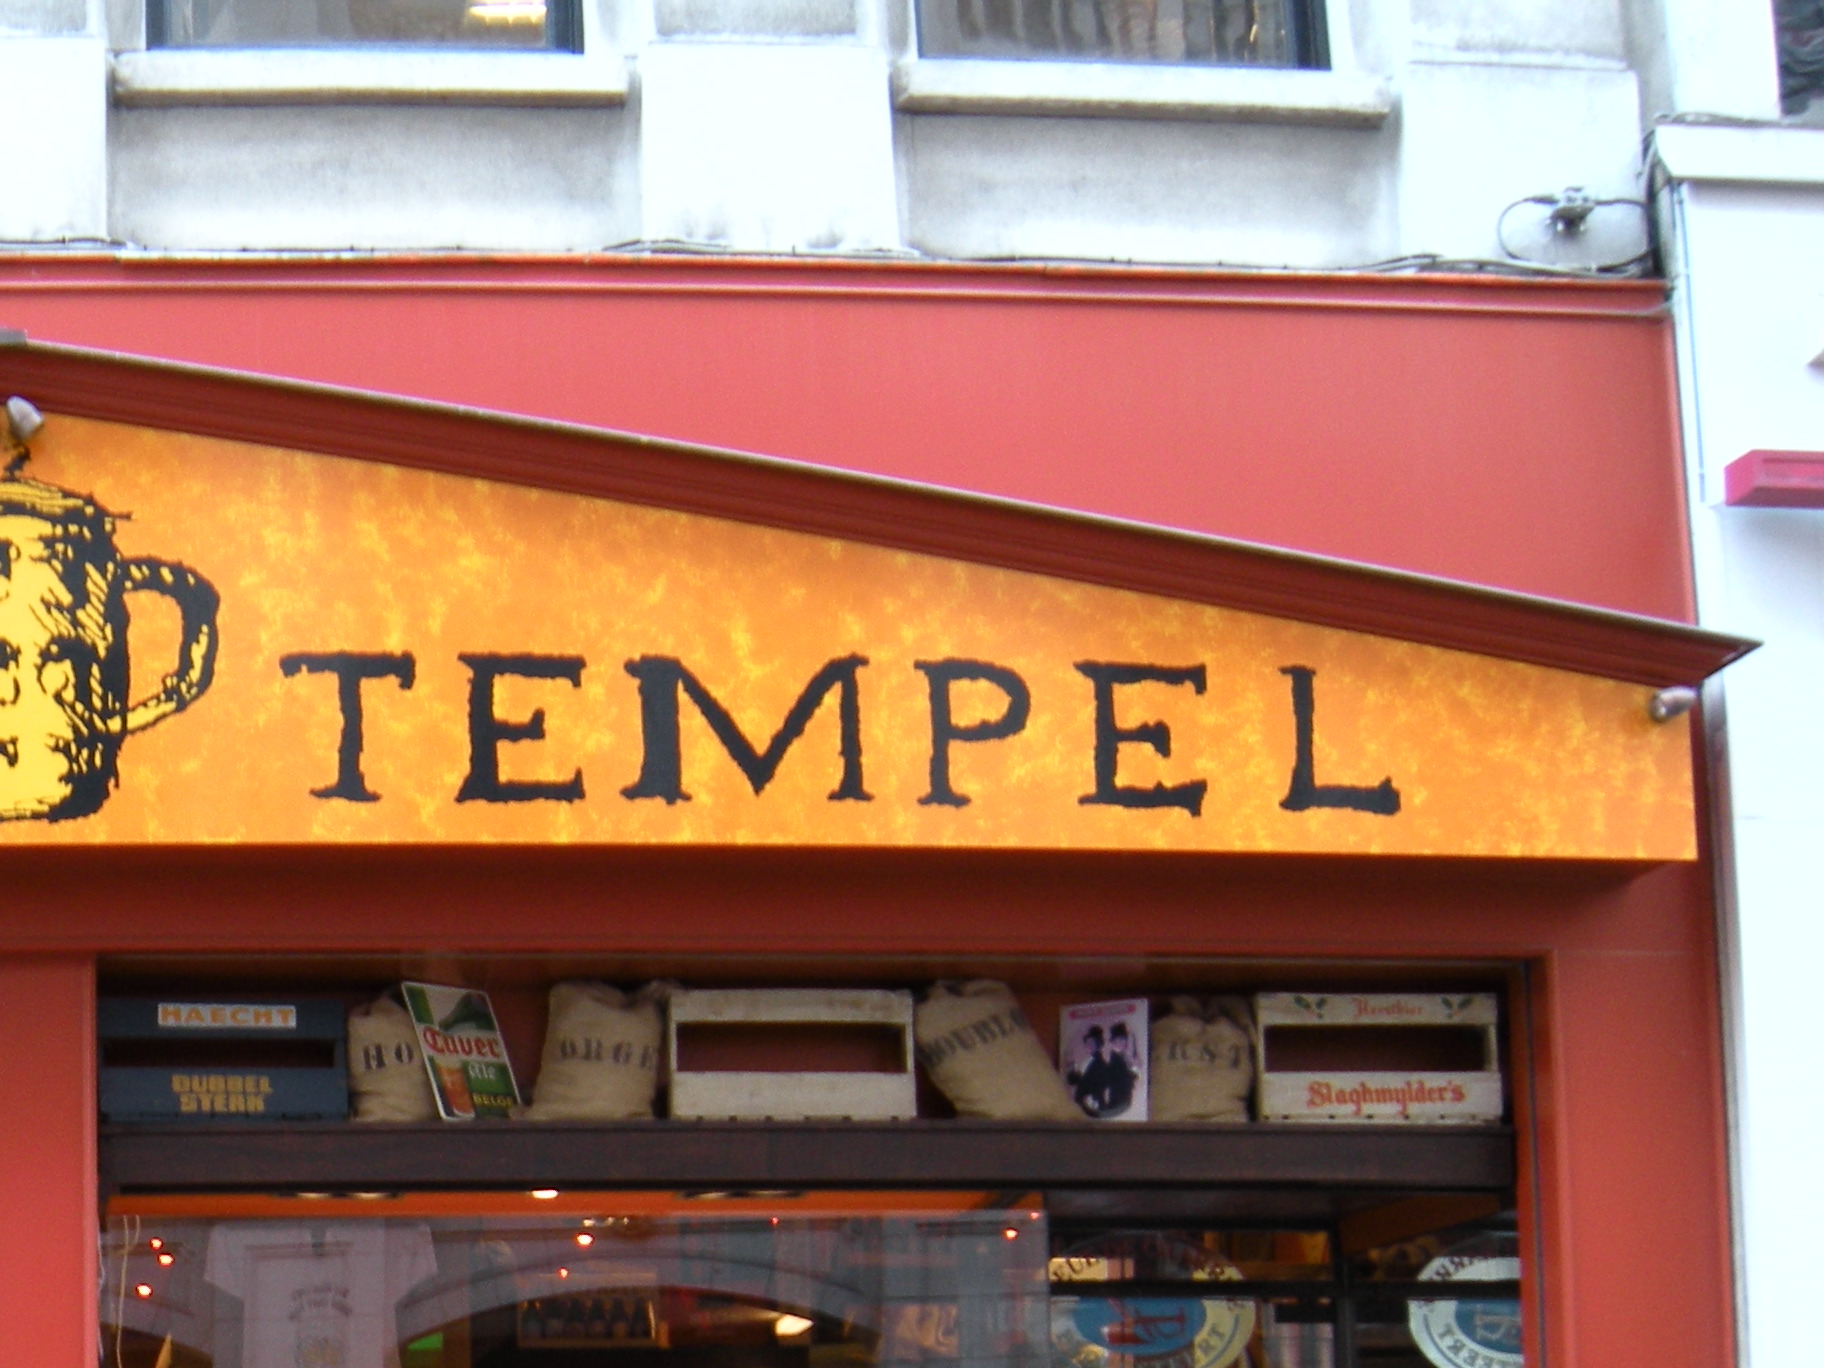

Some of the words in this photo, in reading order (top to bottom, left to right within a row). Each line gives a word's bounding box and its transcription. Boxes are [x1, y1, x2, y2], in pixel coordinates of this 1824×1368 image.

[279, 653, 1402, 816] TEMPEL
[160, 1006, 294, 1025] HAECHT
[172, 1075, 274, 1093] DUBBEL
